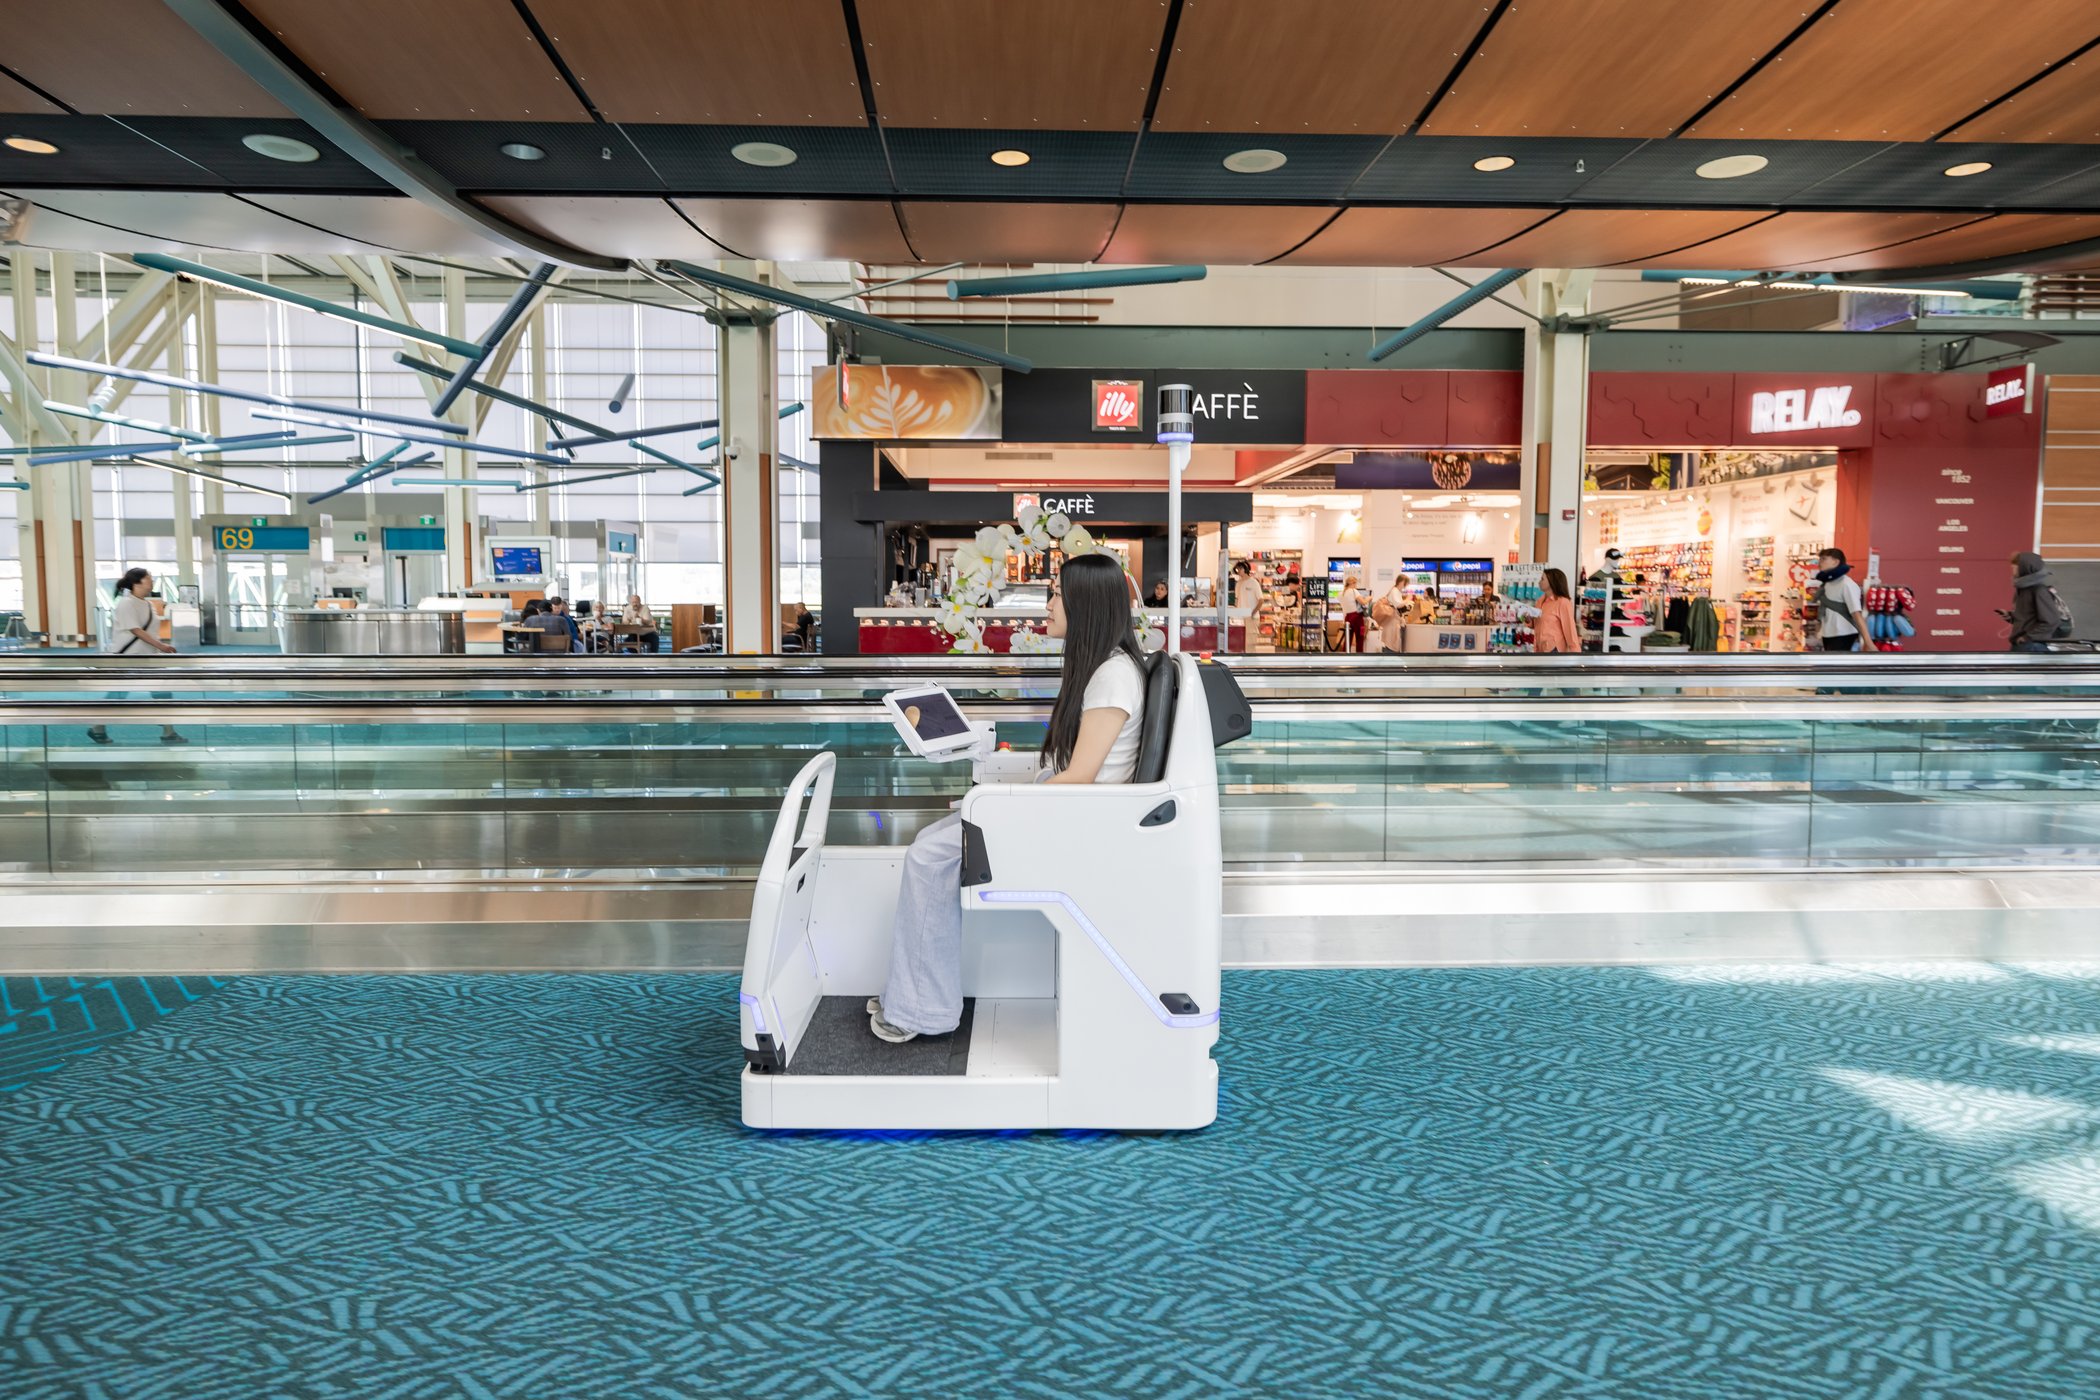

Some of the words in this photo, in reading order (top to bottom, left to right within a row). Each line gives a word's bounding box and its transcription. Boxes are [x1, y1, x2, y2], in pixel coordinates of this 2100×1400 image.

[1100, 391, 1135, 422] illy
[1192, 382, 1259, 420] AFFÈ
[1043, 494, 1095, 514] CAFFÈ
[222, 528, 253, 549] 69
